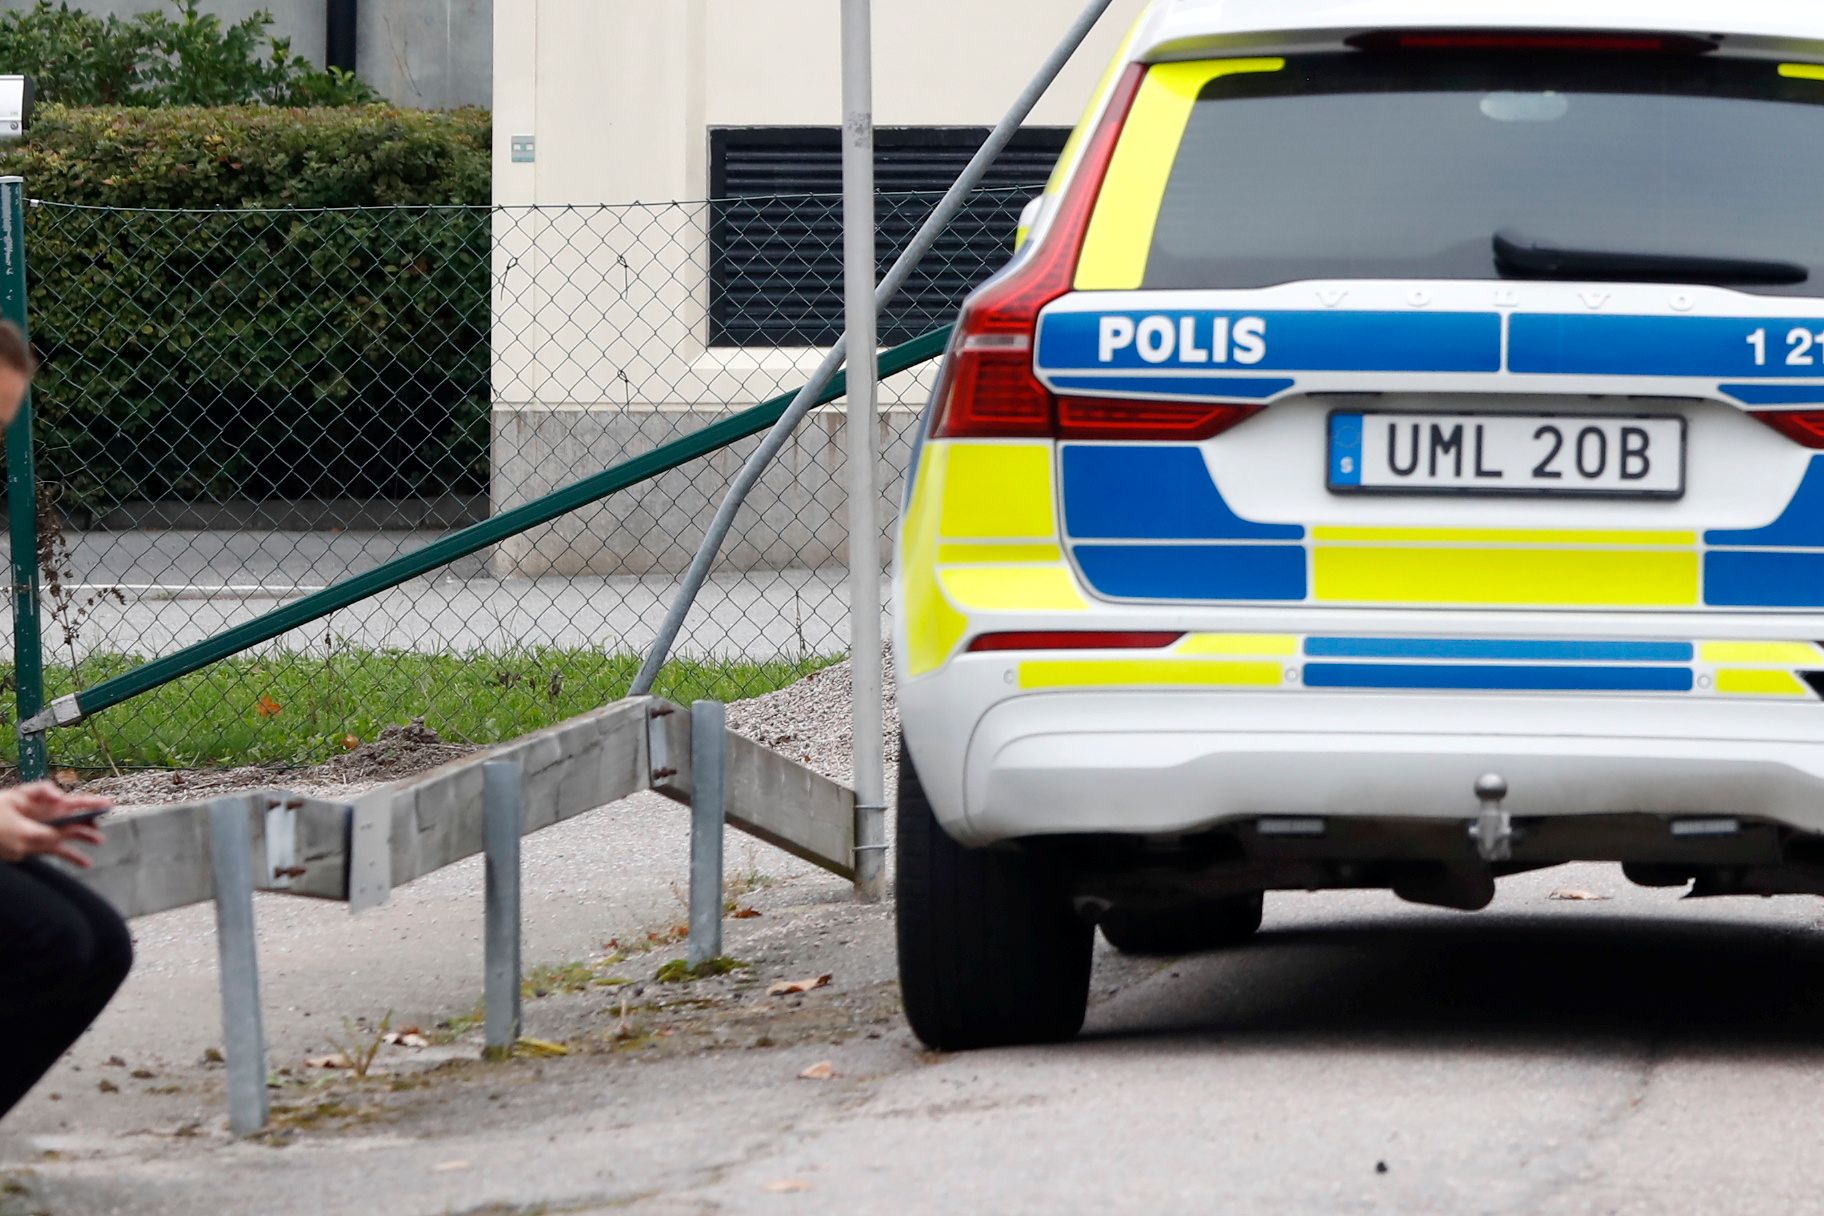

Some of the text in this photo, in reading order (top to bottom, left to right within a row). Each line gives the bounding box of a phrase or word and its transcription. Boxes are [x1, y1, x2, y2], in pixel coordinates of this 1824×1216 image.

[1098, 315, 1267, 364] POLIS
[1746, 328, 1766, 366] 1
[1339, 456, 1354, 474] S
[1387, 422, 1651, 481] UML 20B
